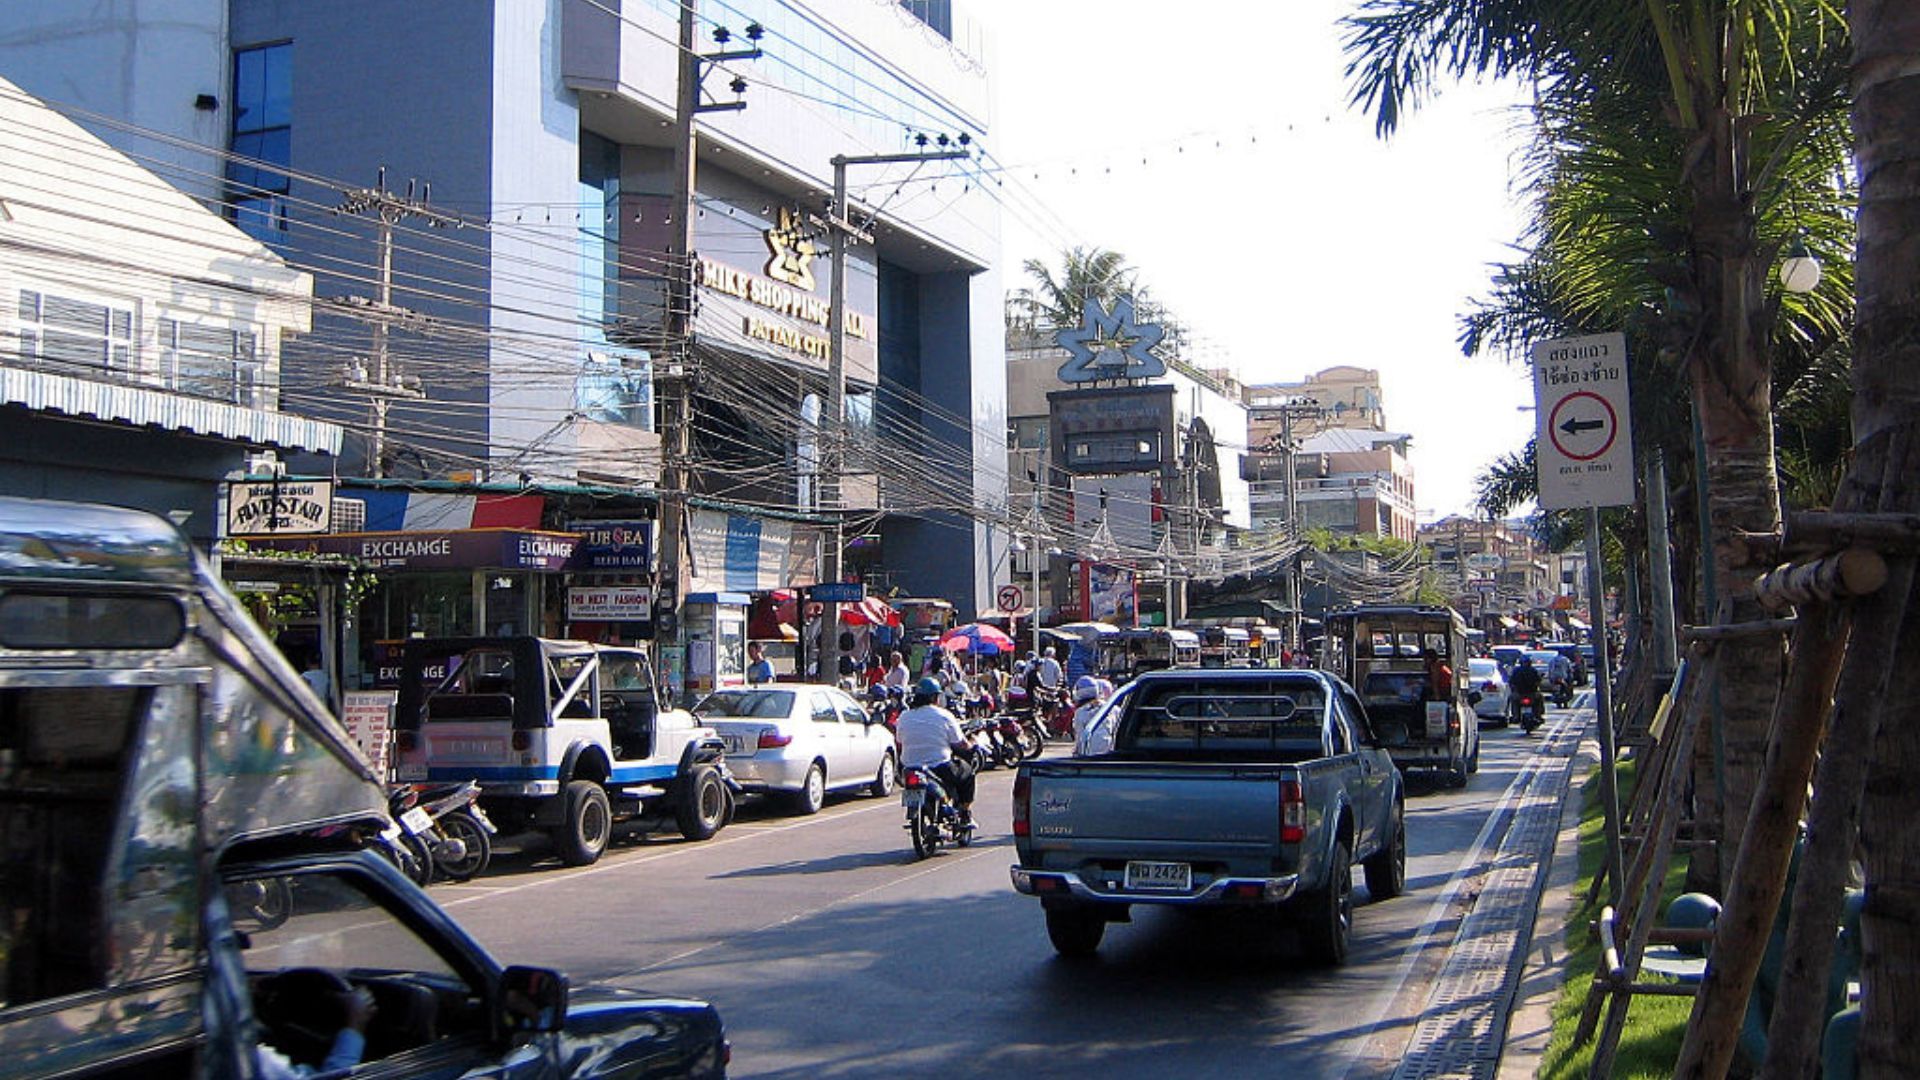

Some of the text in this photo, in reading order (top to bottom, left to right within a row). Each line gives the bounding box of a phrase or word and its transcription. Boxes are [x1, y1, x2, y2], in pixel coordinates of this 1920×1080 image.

[701, 258, 749, 299] MIKE
[750, 277, 831, 328] SHOPPING
[750, 315, 831, 359] PATTAYA CITY
[362, 539, 451, 558] EXCHANGE
[519, 539, 573, 558] EXCHANGE
[380, 665, 445, 679] EXCNGE
